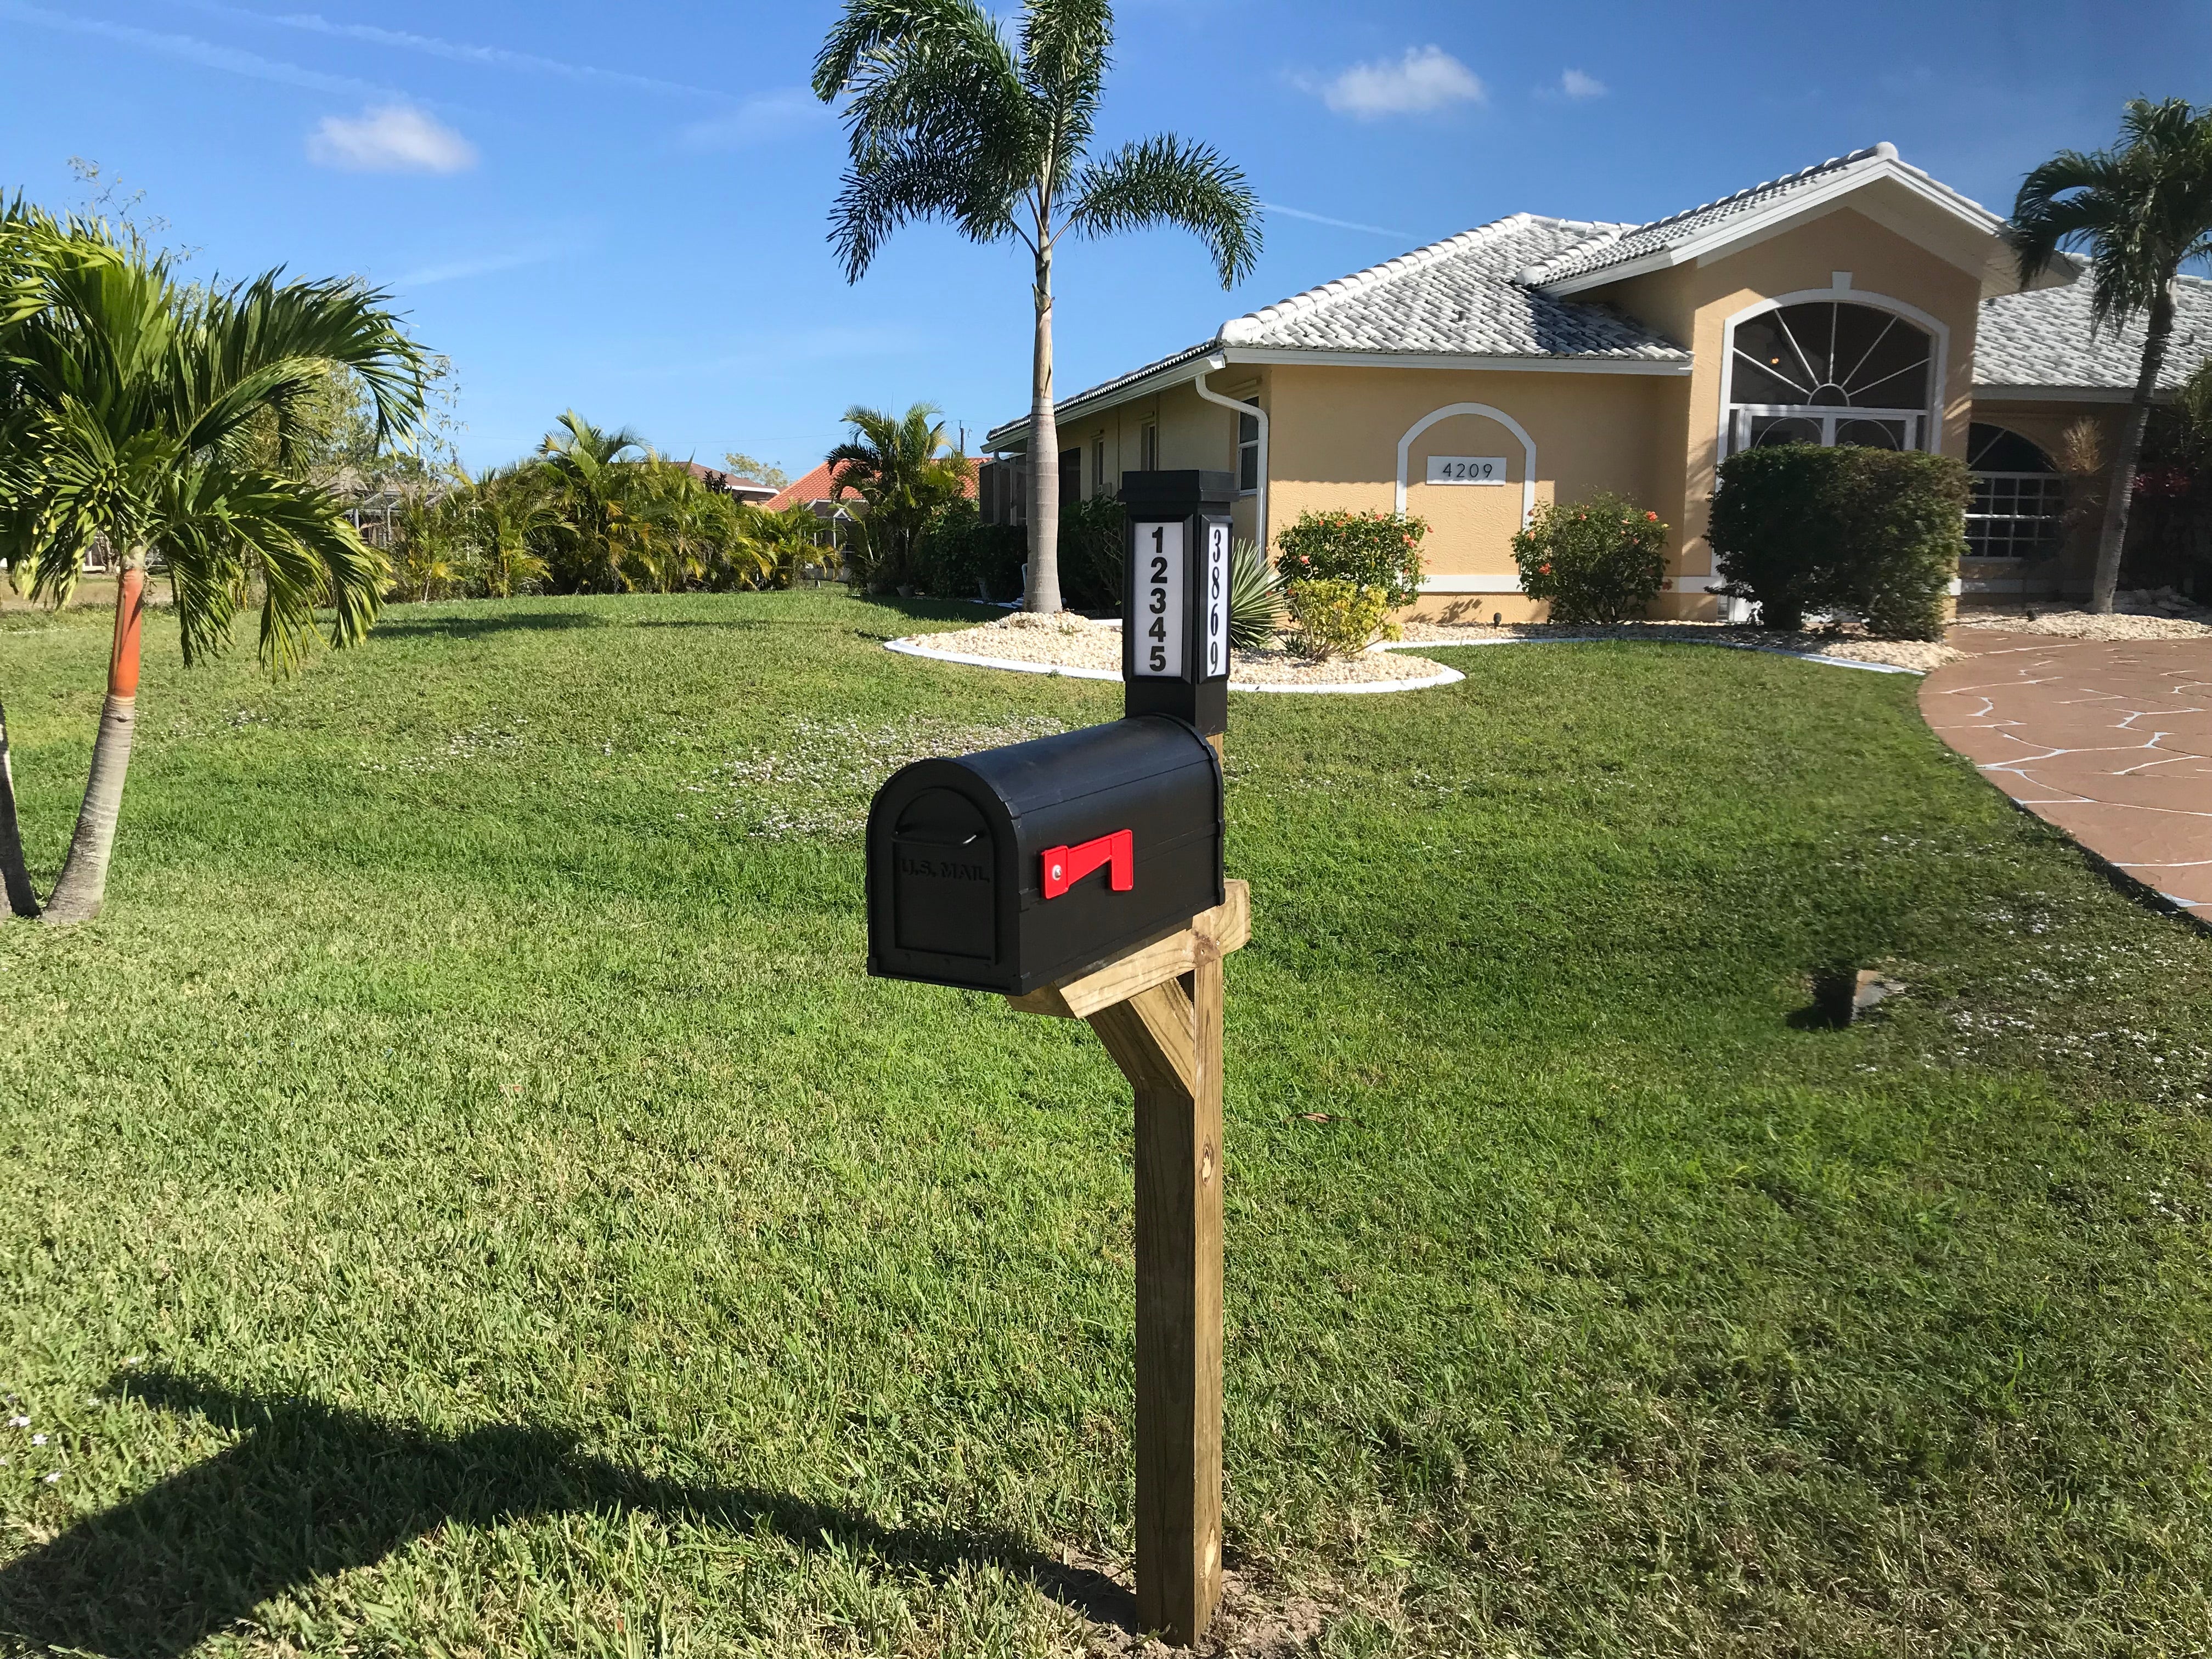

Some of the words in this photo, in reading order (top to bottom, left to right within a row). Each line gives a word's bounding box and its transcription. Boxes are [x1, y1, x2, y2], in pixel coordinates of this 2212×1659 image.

[1443, 463, 1492, 478] 4209
[1149, 527, 1168, 672] 12345
[1210, 529, 1221, 675] 3869
[901, 859, 936, 877] U.S.
[940, 862, 990, 883] MAIL
